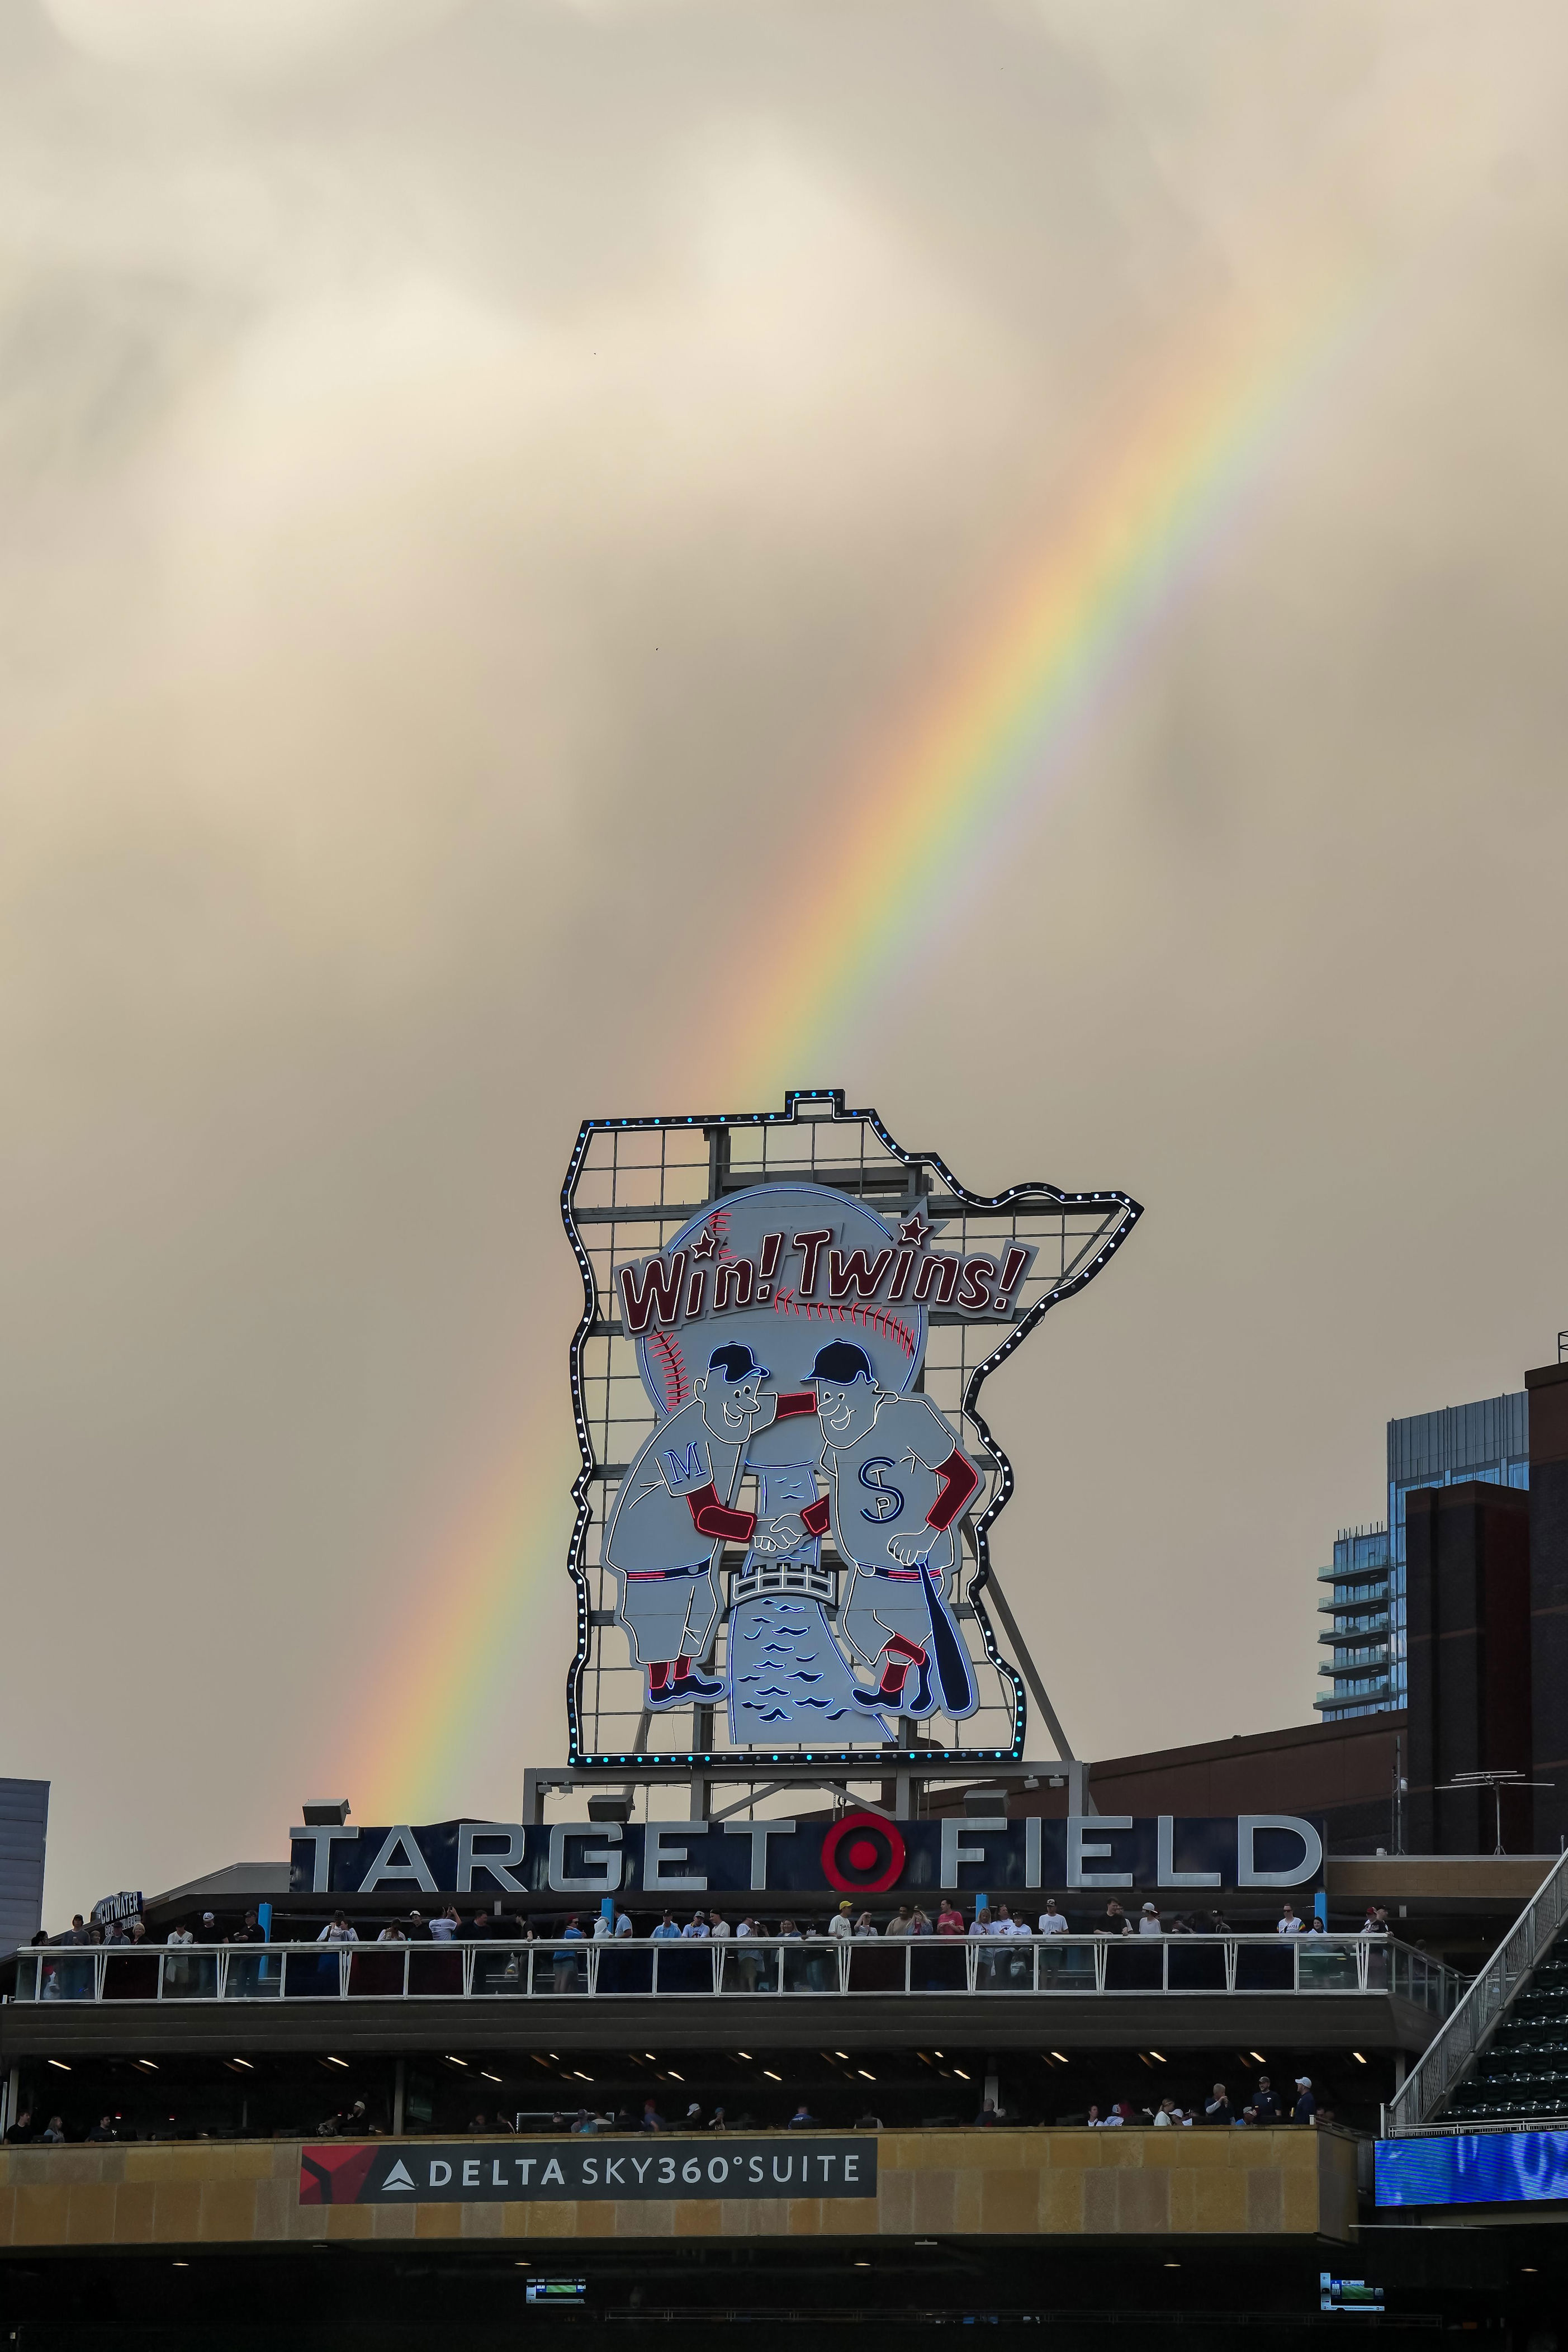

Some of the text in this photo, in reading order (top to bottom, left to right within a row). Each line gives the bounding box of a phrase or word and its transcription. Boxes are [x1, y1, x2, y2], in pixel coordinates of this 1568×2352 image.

[619, 1215, 1029, 1335] Win! Twins!
[663, 1441, 707, 1485] M
[289, 1815, 1323, 1892] TARGET FIELD
[101, 1892, 138, 1924] CUTWATER
[429, 2159, 565, 2187] DELTA
